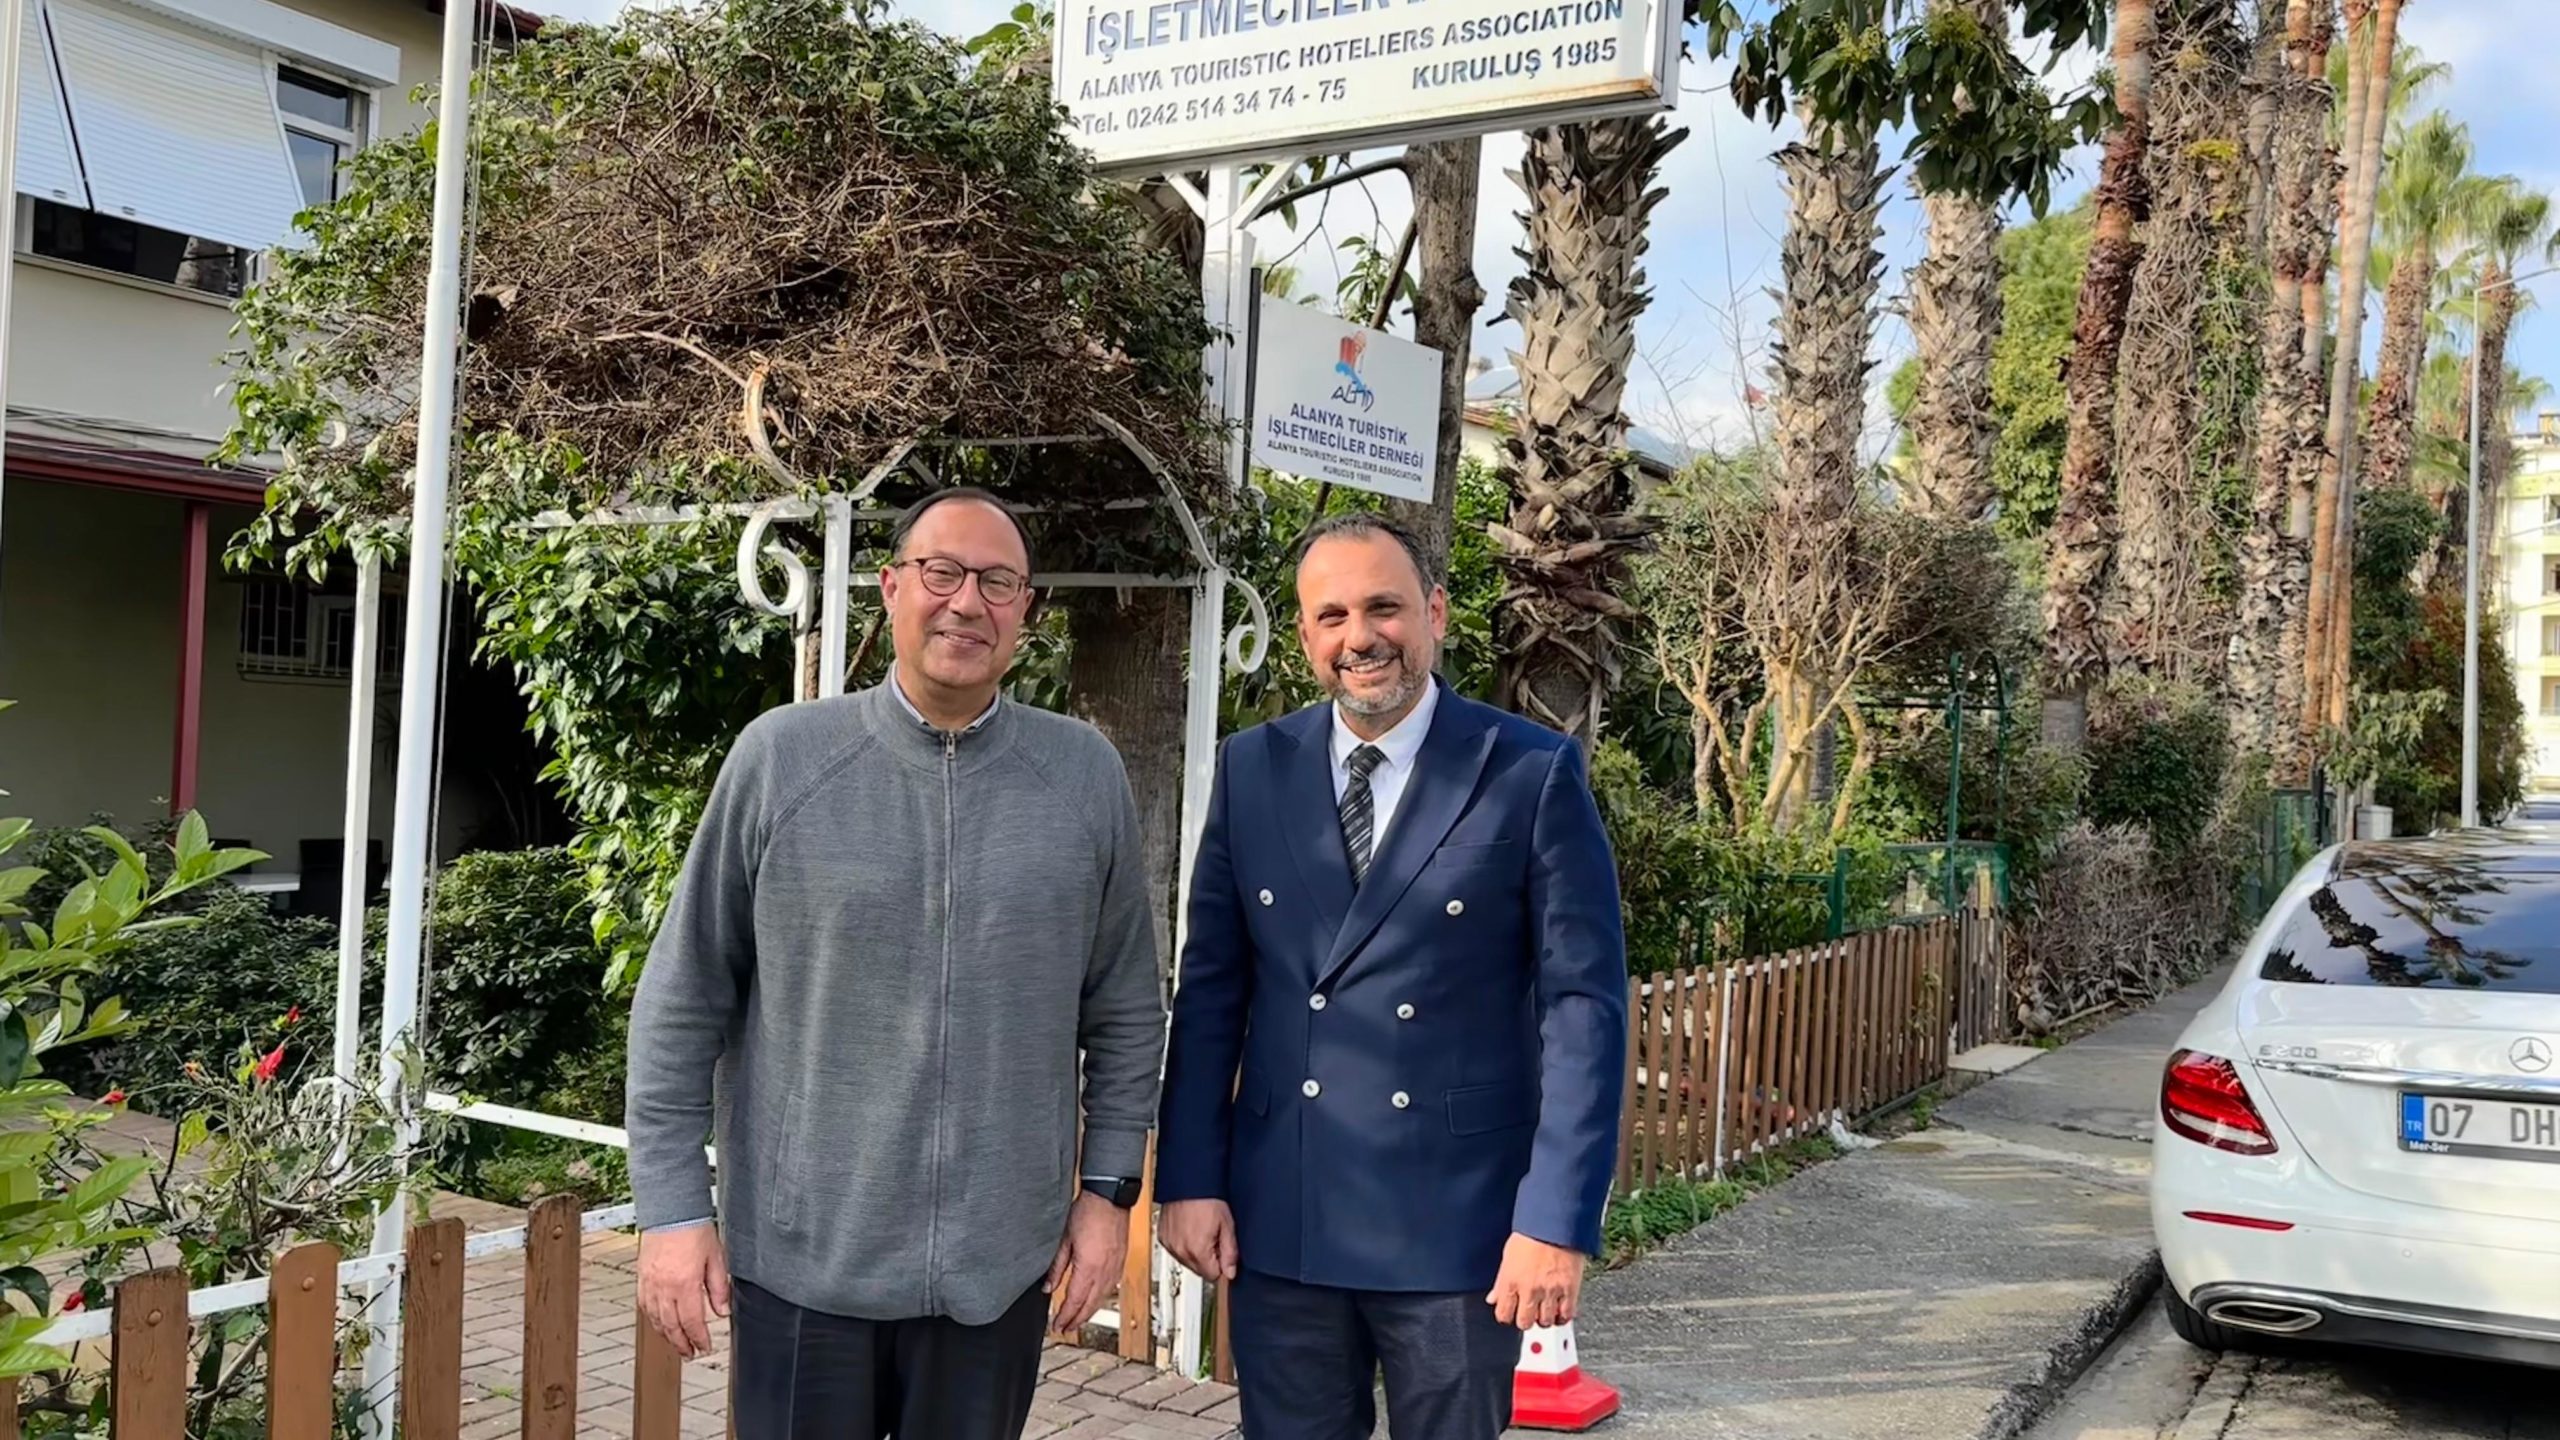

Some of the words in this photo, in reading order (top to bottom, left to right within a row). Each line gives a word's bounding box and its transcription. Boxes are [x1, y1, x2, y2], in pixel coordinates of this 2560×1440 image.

[1080, 69, 1163, 101] ALANYA
[1171, 49, 1291, 88] TOURISTIC
[1300, 26, 1434, 68] HOTELIERS
[1442, 0, 1623, 46] ASSOCIATION
[1085, 0, 1390, 65] İŞLETMECL
[1412, 48, 1541, 90] KURULUŞ
[1552, 37, 1617, 69] 1985
[1082, 111, 1119, 136] Tel.
[1127, 102, 1178, 130] 0242
[1186, 96, 1225, 122] 514
[1233, 90, 1260, 115] 34
[1268, 85, 1296, 110] 74
[1318, 77, 1346, 103] 75
[1268, 413, 1366, 456] İŞLETMECİLER
[1369, 442, 1424, 470] DERNEĞİ
[1290, 402, 1344, 429] ALANYA
[1348, 416, 1408, 446] TURİSTİK
[2406, 1120, 2423, 1132] TR
[2430, 1102, 2474, 1140] 07
[2511, 1106, 2560, 1147] DH
